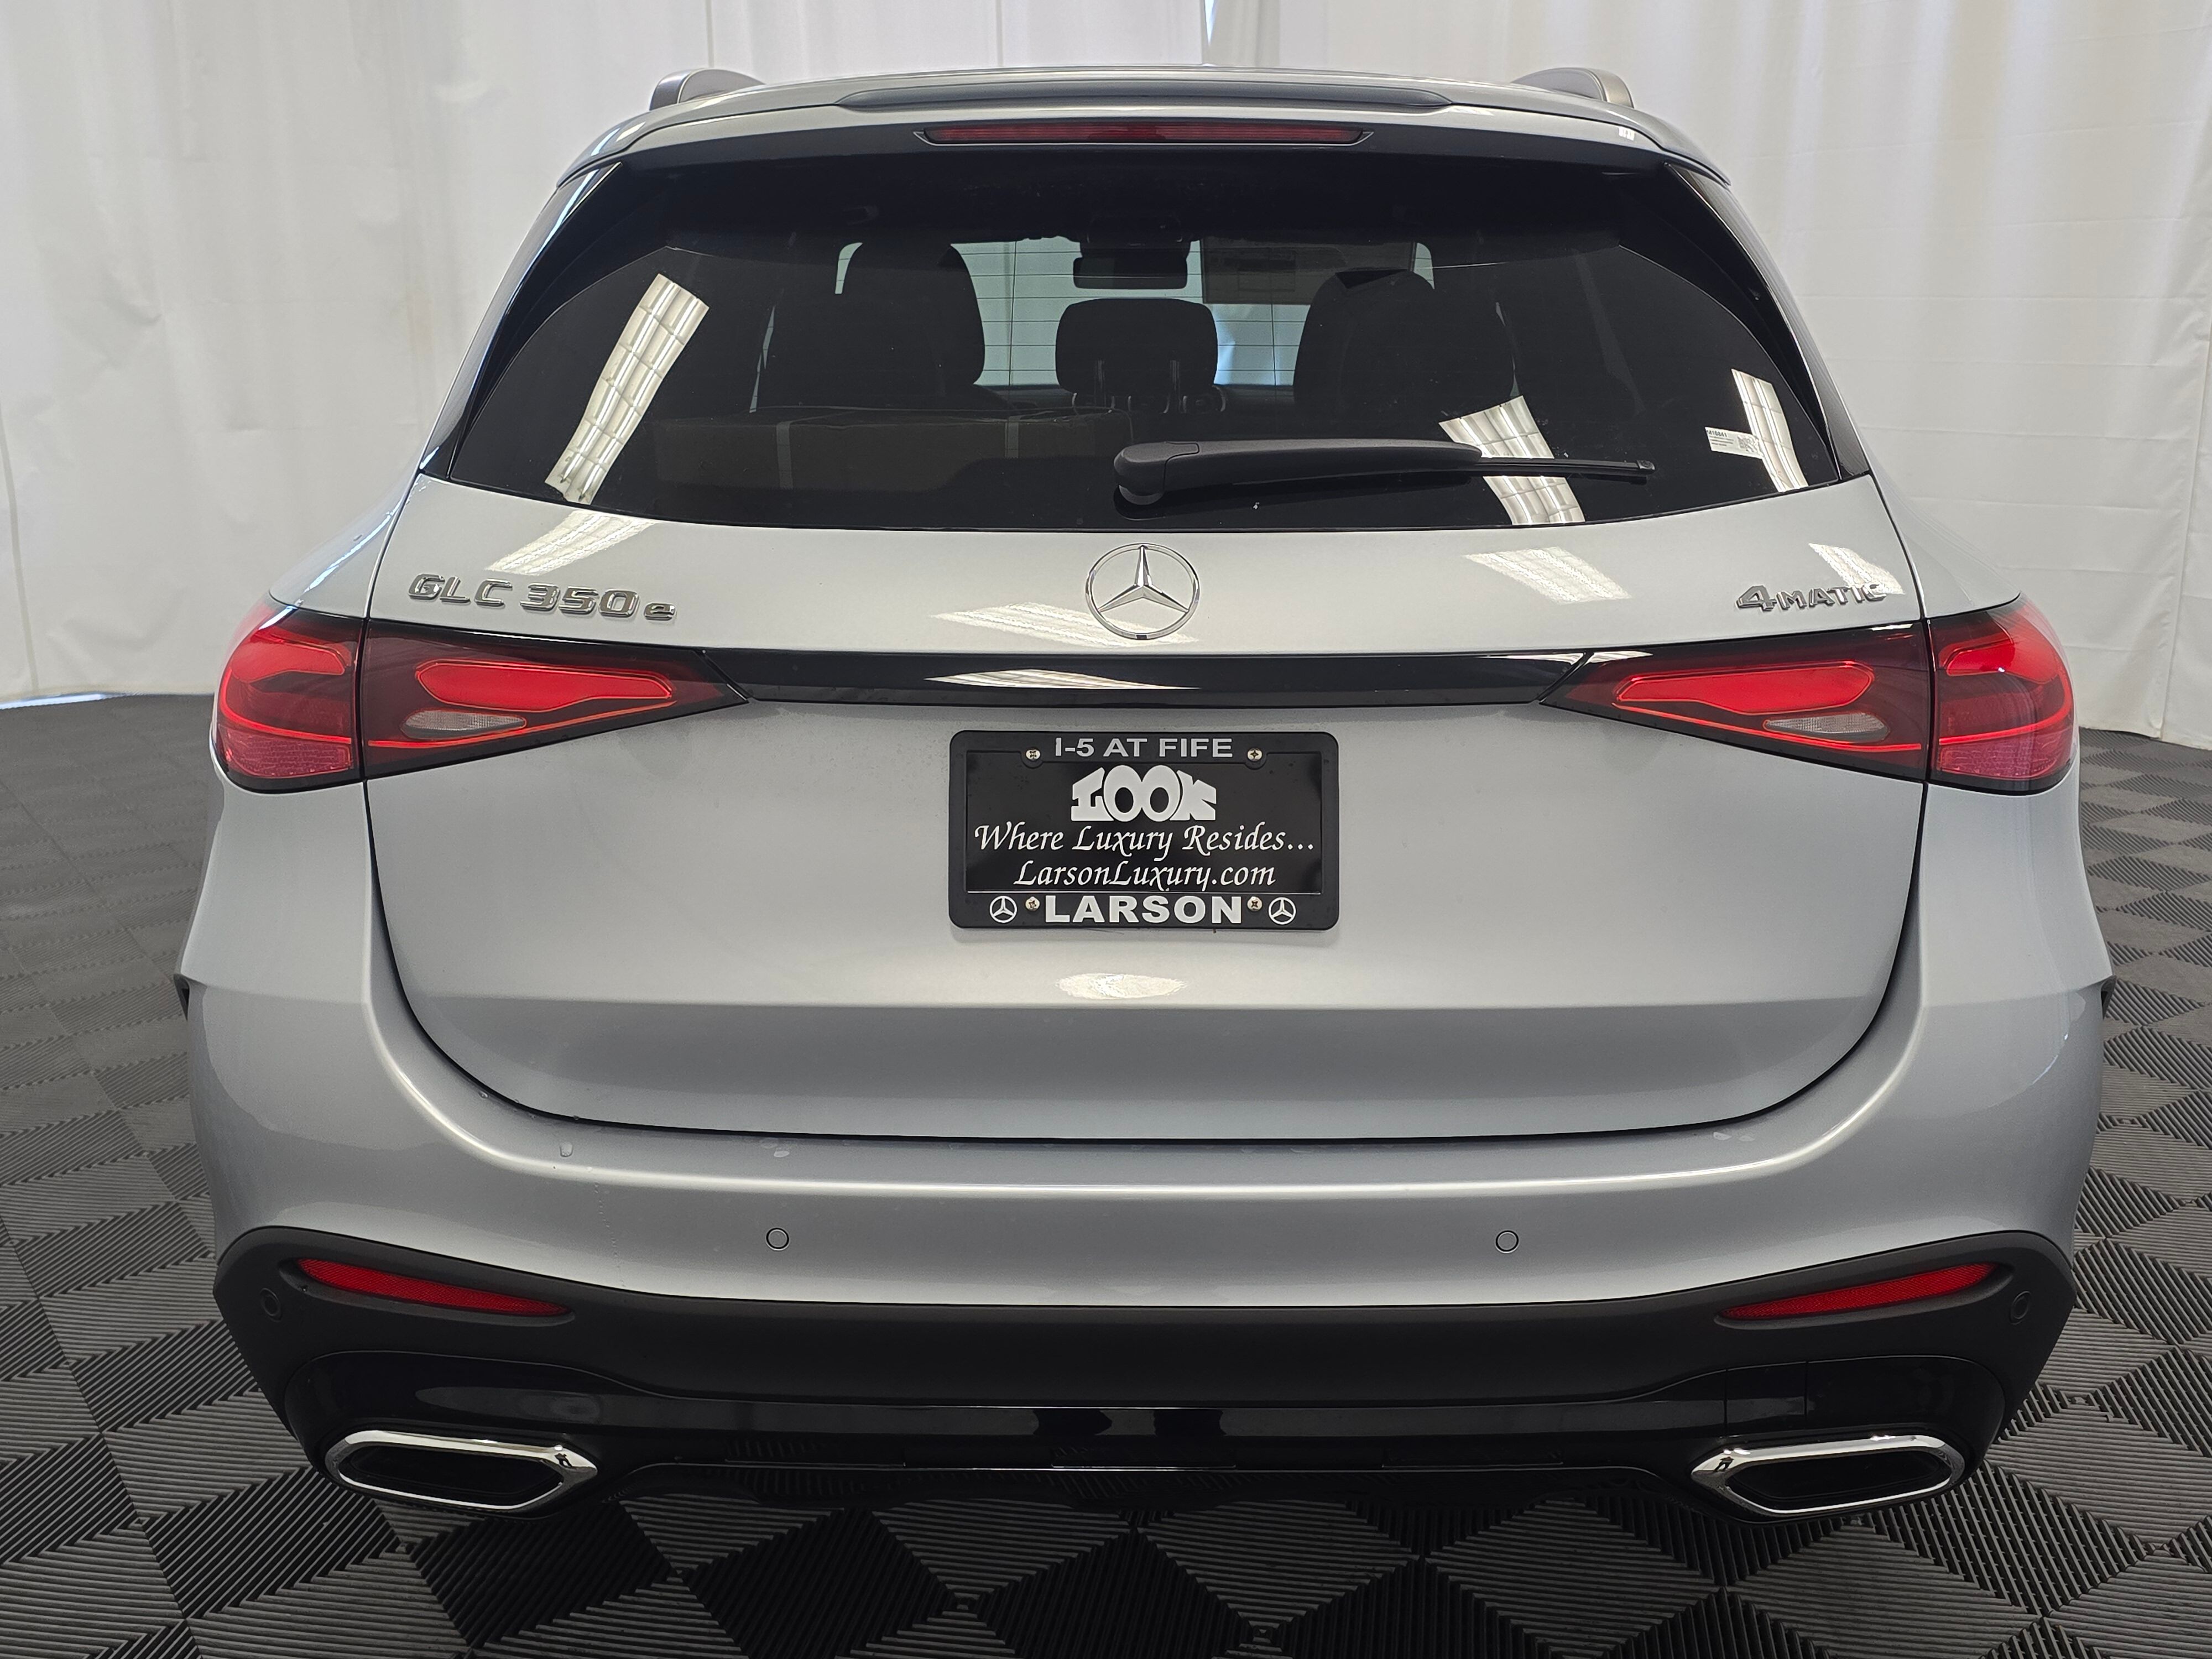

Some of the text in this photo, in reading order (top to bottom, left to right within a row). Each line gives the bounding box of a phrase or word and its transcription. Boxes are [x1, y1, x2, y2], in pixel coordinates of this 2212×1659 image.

[408, 573, 676, 620] GLC 350 e
[1736, 583, 1887, 611] 4MATIC
[1055, 738, 1233, 758] I-5 AT FIFE
[1071, 765, 1217, 822] LOOK
[974, 822, 1314, 861] Where Luxury Resides...
[1013, 860, 1276, 891] LarsonLuxury.com
[1045, 895, 1241, 924] LARSON
